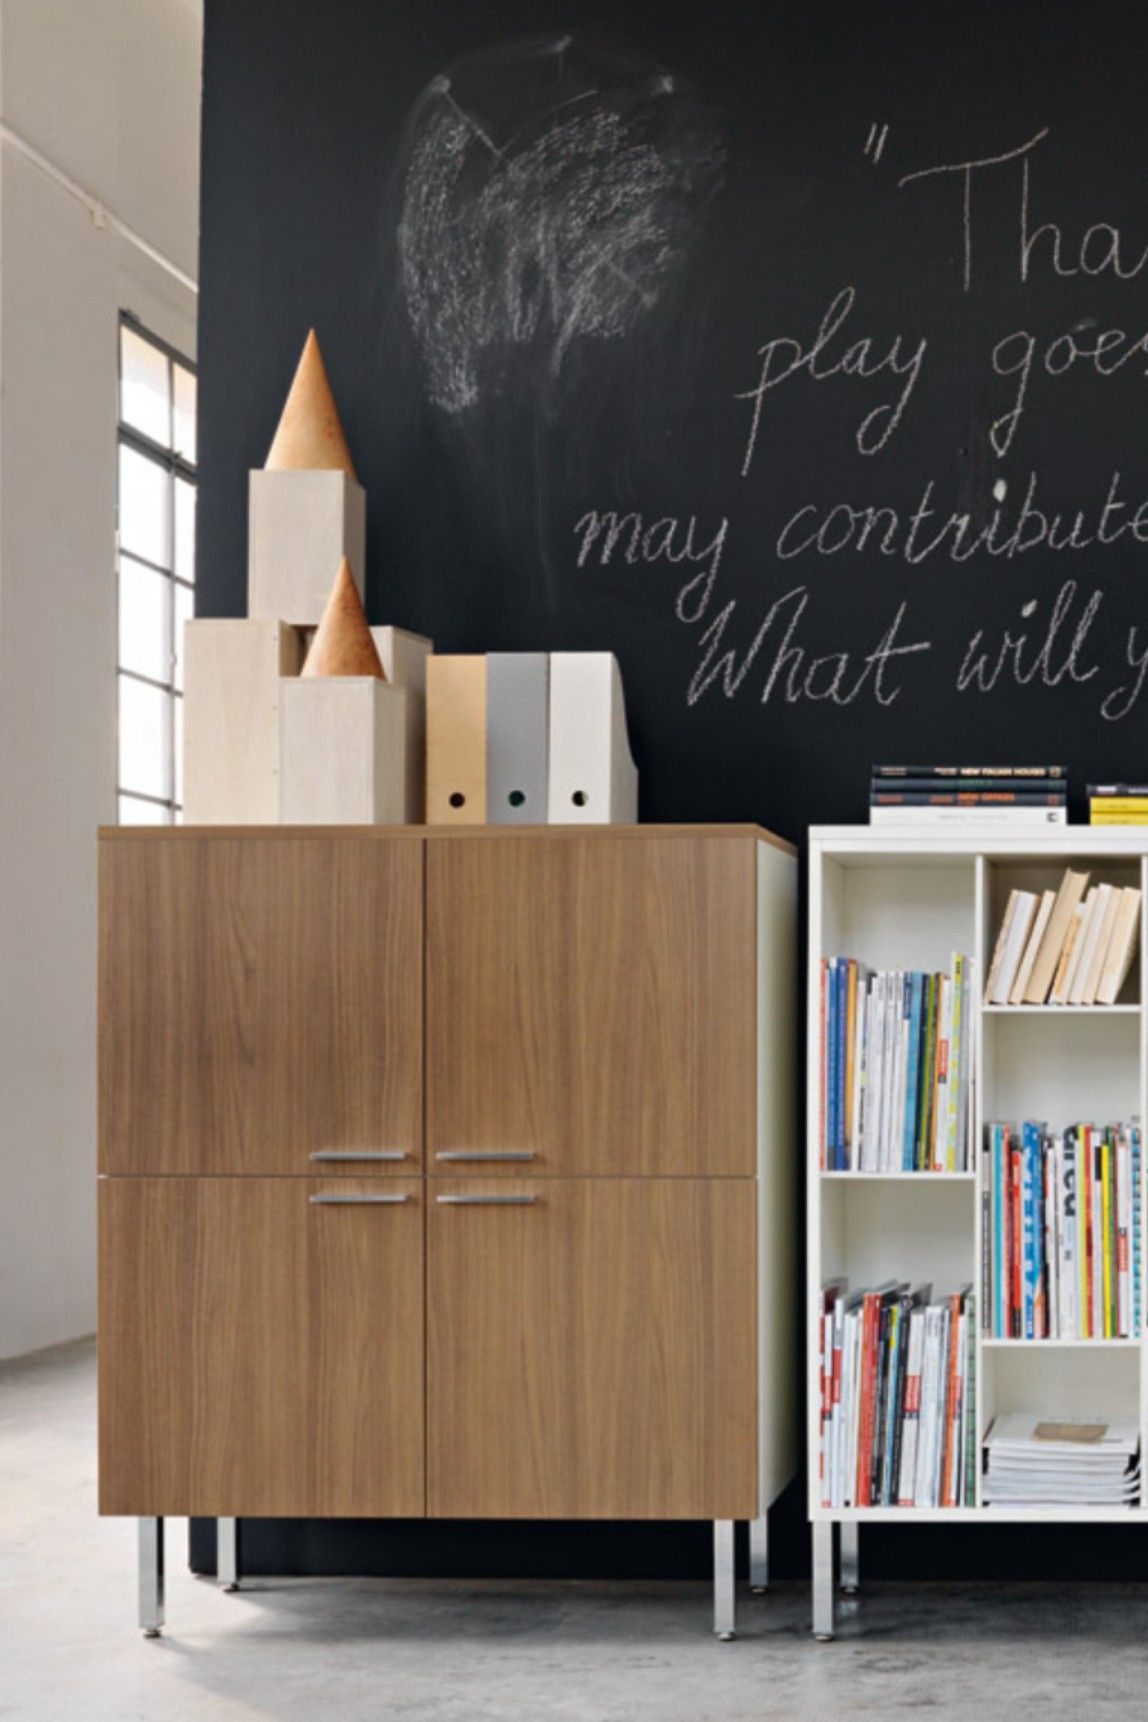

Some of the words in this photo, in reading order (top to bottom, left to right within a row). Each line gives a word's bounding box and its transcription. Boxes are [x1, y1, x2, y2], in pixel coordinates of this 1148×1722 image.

[735, 287, 928, 477] play
[574, 510, 729, 623] may
[687, 586, 932, 706] What
[957, 580, 1104, 692] will
